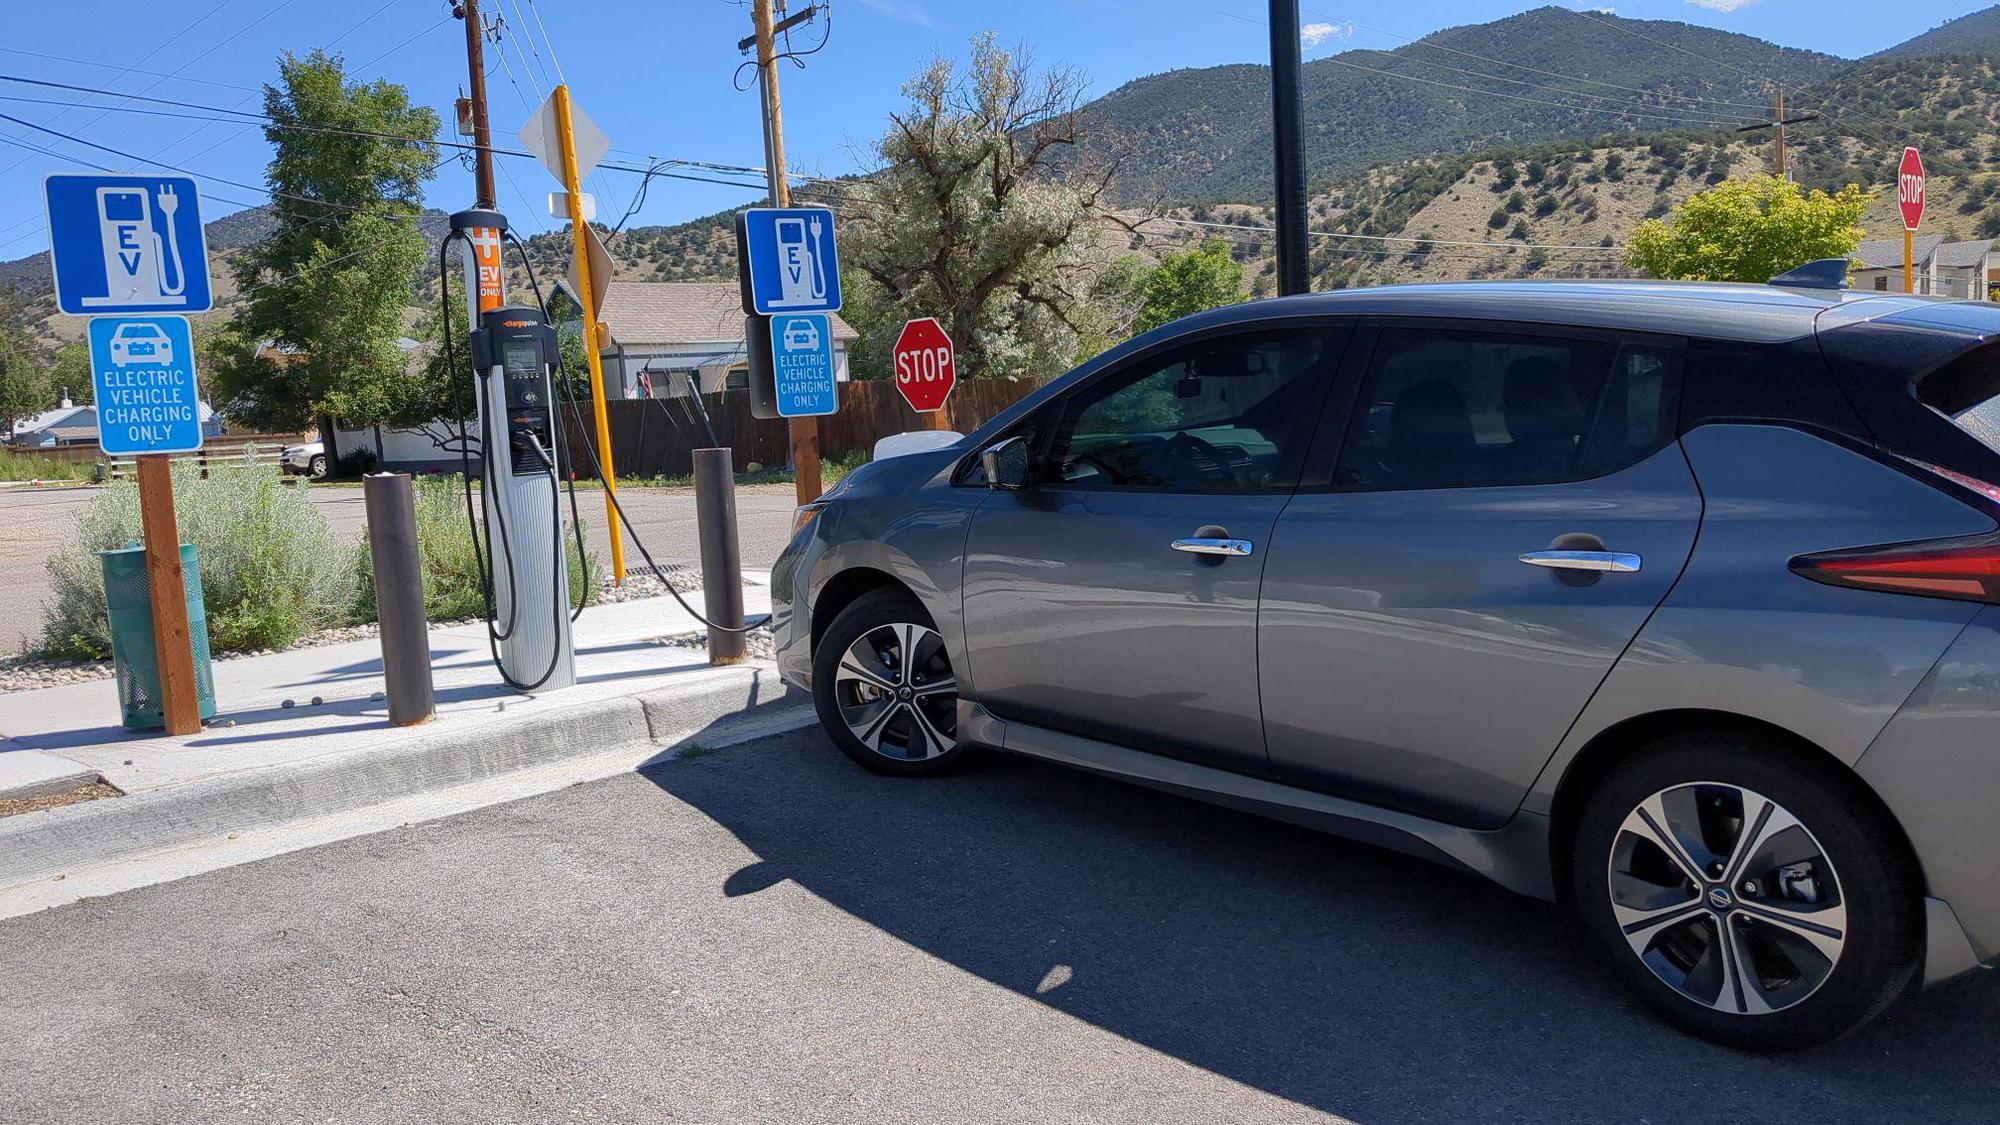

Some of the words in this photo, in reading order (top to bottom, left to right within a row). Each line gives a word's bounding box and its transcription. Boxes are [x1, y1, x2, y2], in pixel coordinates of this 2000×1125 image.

[1901, 173, 1923, 204] STOP
[480, 266, 499, 281] EV
[480, 288, 502, 297] ONLY
[780, 353, 826, 368] ELECTRIC
[898, 347, 950, 385] STOP
[105, 369, 185, 388] ELECTRIC
[783, 367, 825, 380] VEHICLE
[780, 380, 830, 394] CHARGING
[110, 388, 183, 406] VEHICLE
[793, 394, 820, 408] ONLY
[105, 406, 192, 425] CHARGING
[128, 424, 173, 442] ONLY
